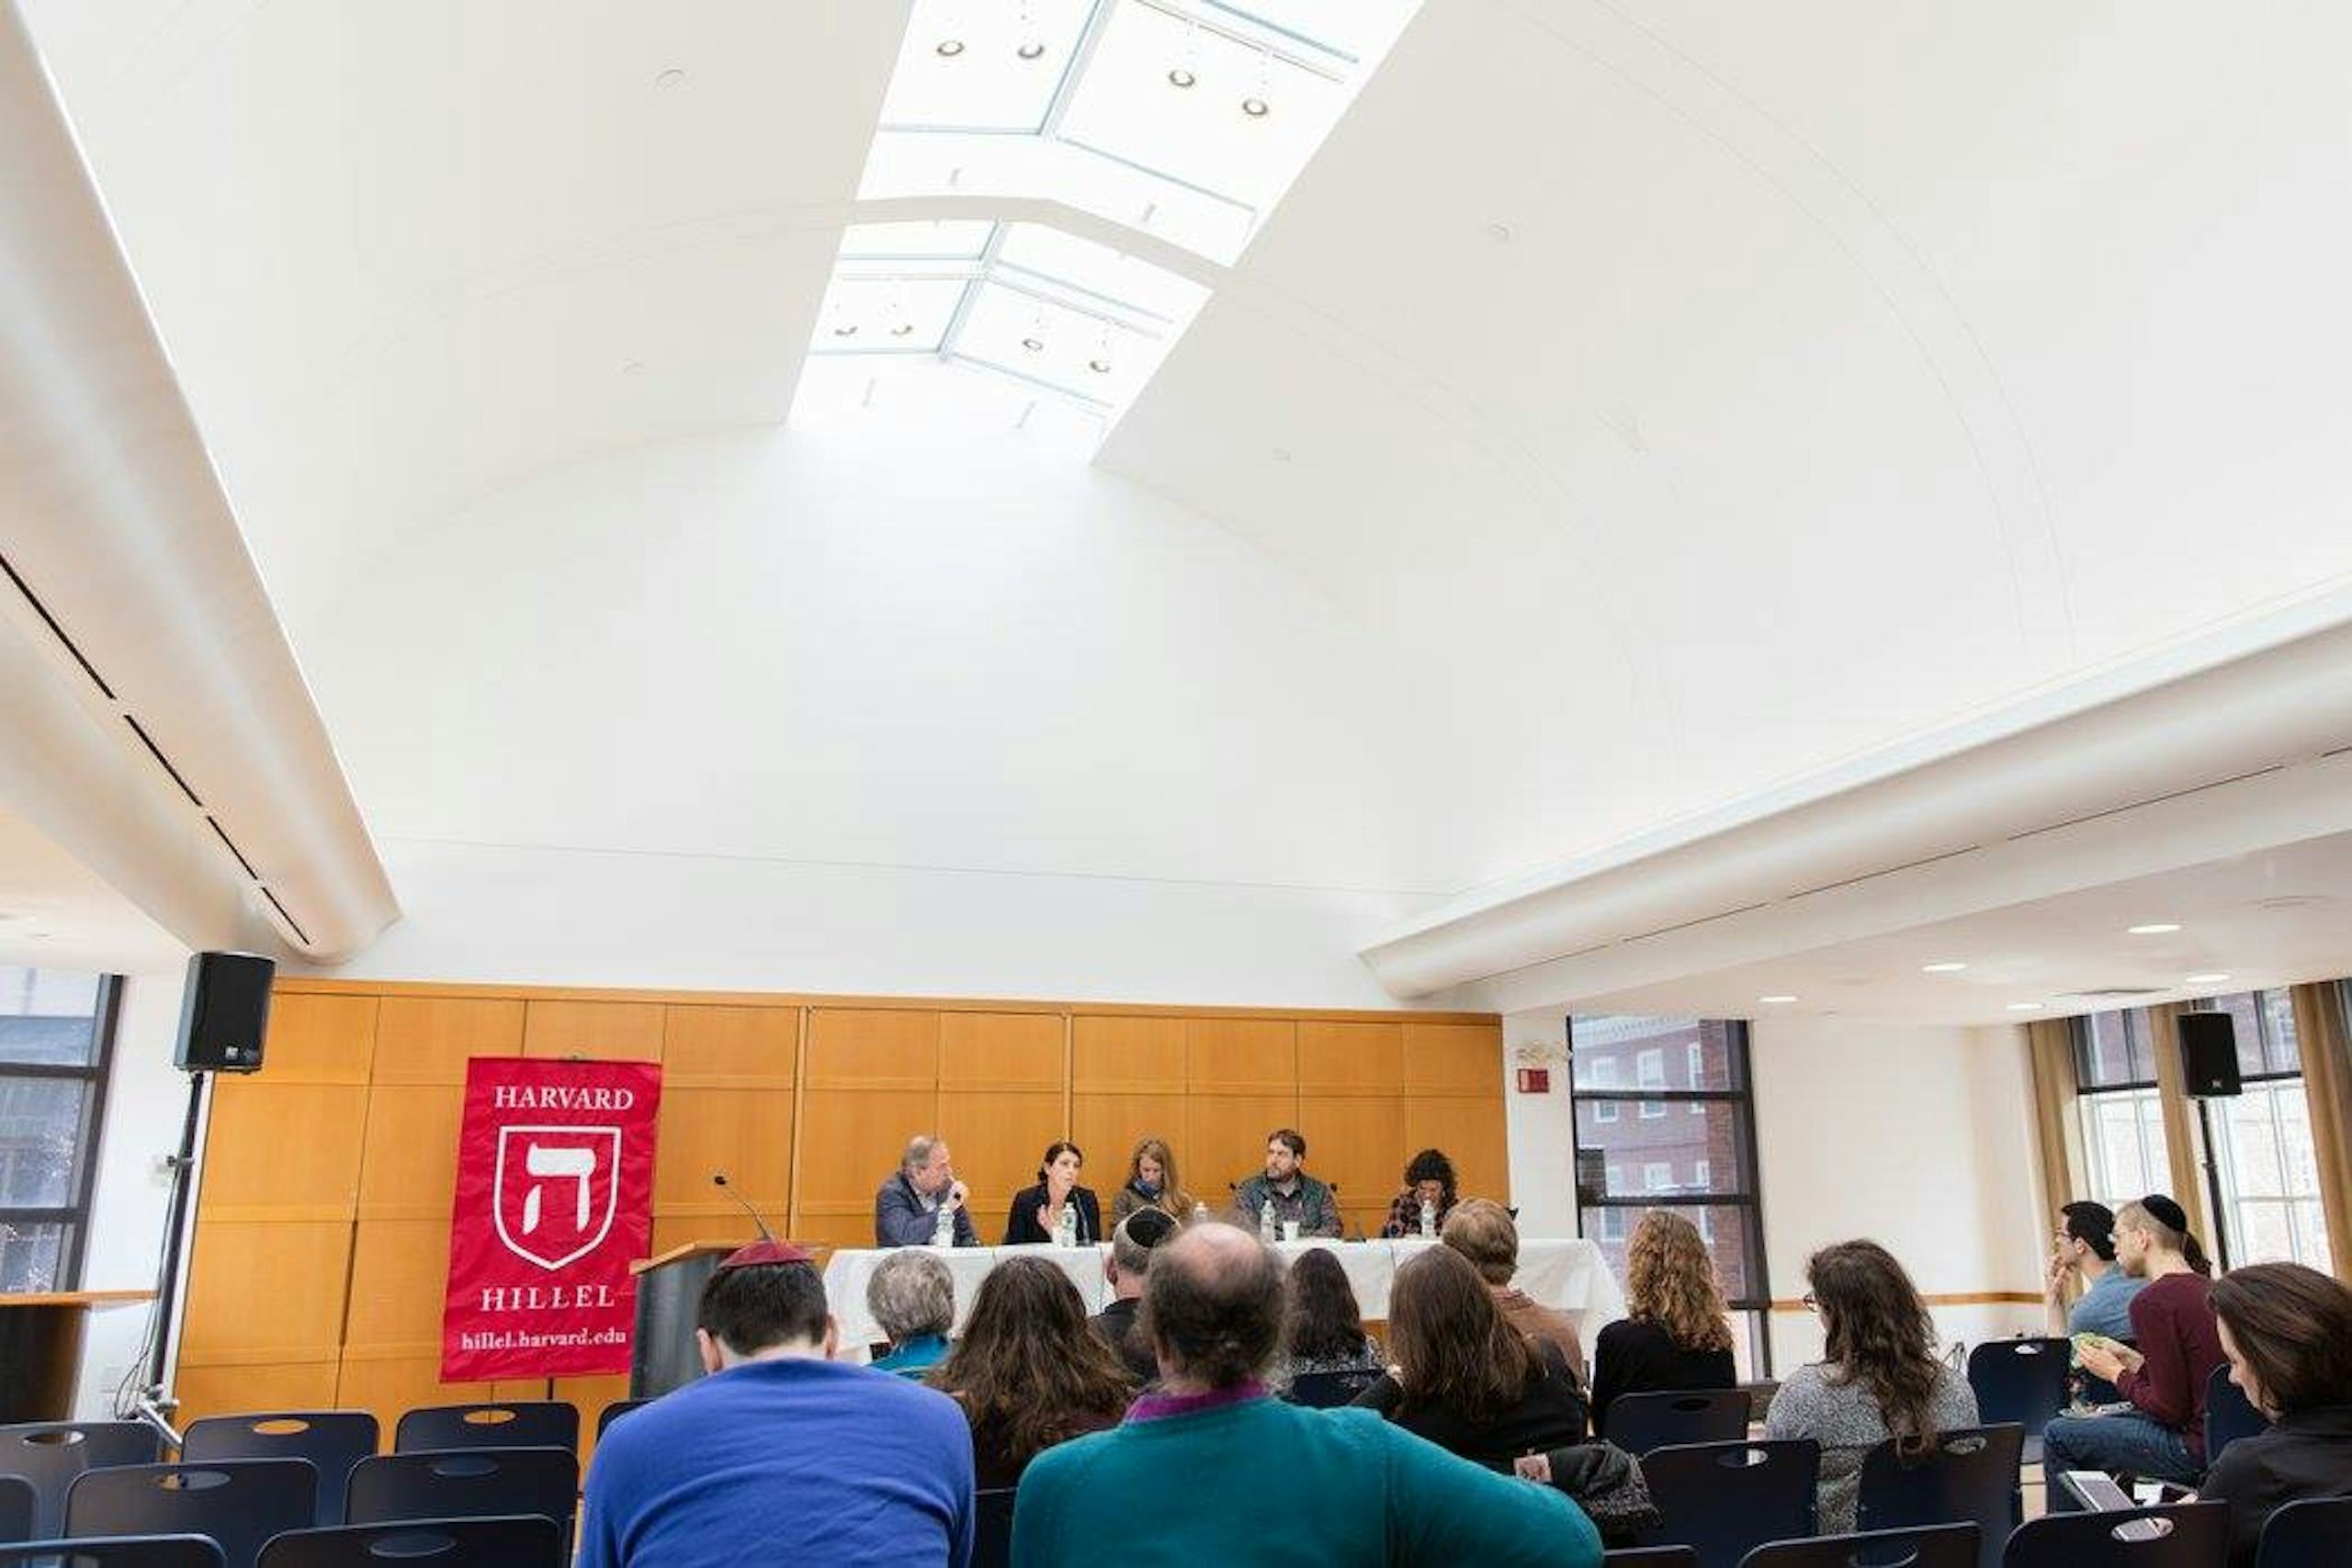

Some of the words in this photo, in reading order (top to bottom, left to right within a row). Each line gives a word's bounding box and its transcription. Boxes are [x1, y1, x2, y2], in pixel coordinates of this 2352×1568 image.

[494, 1086, 634, 1111] HARVARD
[481, 1284, 615, 1312] HILLEL
[461, 1327, 627, 1350] hillel.harvard.edu
